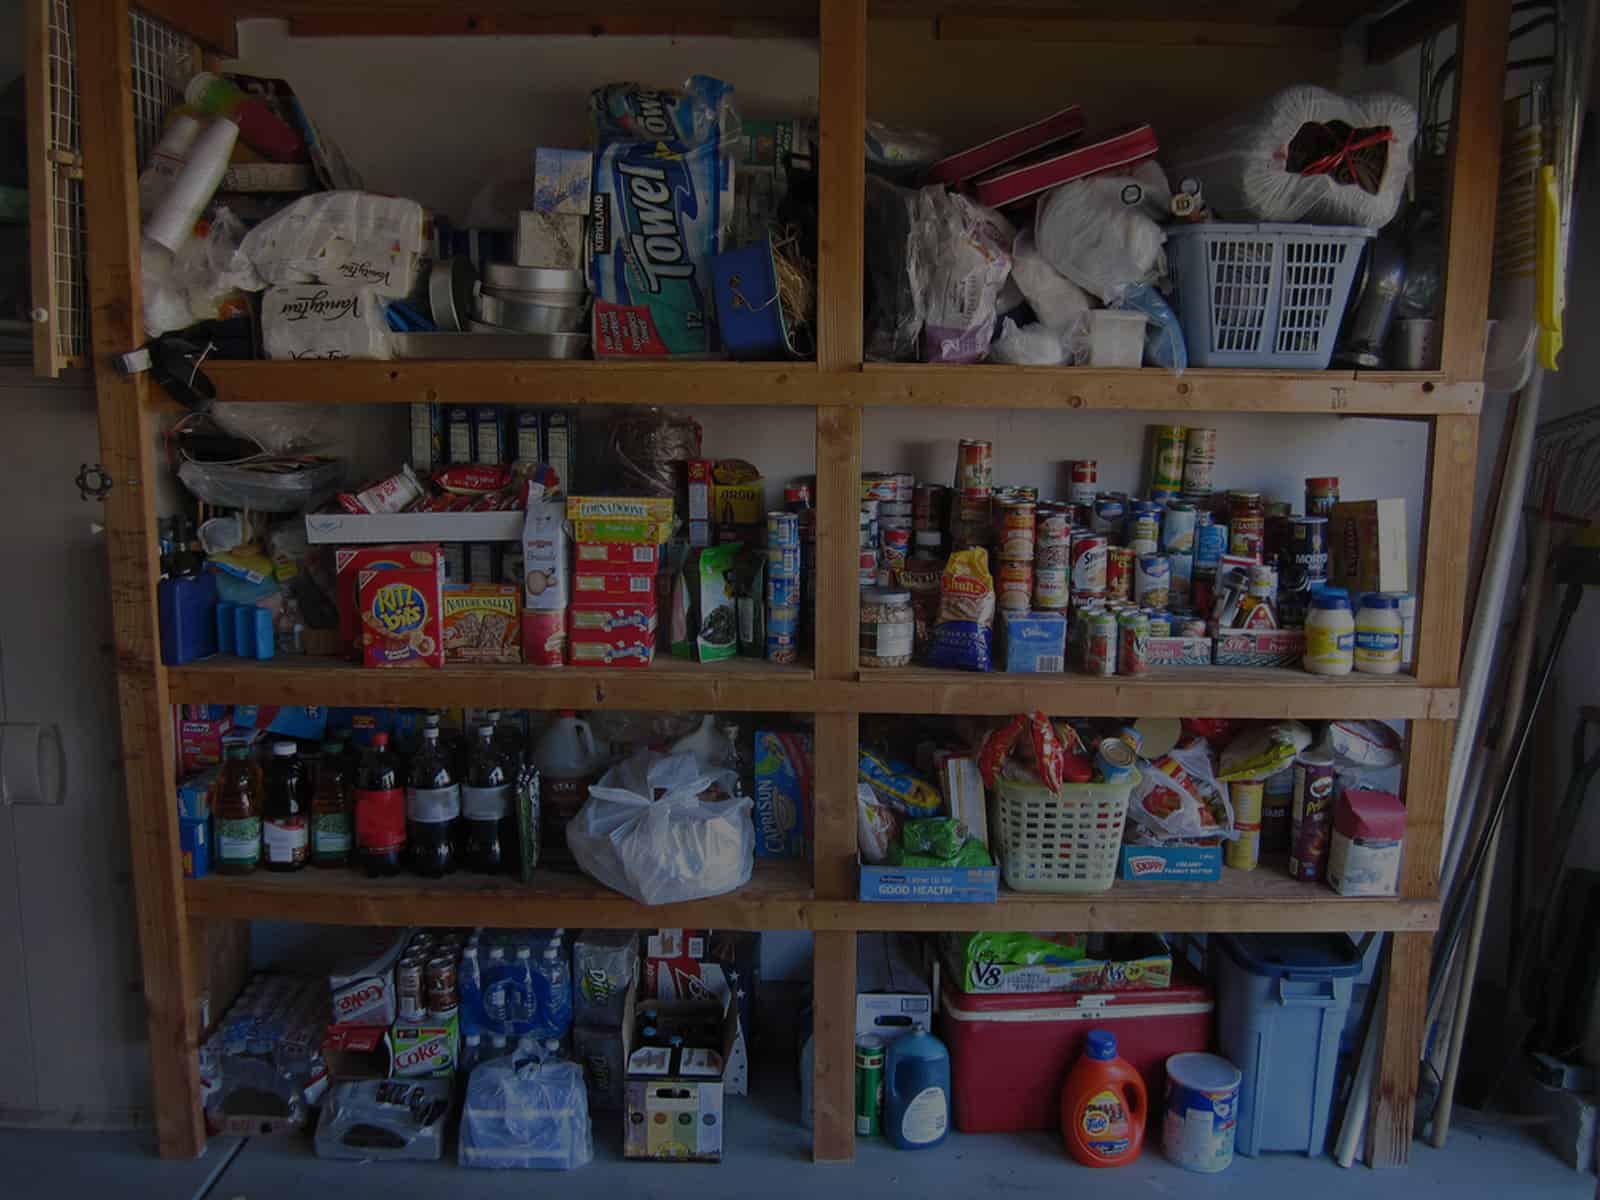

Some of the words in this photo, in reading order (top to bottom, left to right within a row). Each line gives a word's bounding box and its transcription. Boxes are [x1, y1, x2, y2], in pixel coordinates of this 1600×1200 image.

[594, 195, 605, 251] KIRKLAND
[615, 160, 696, 294] Towel
[376, 585, 416, 613] RITZ
[446, 599, 479, 612] NATURE
[480, 599, 516, 612] VALLEY
[879, 885, 909, 895] GOOD
[912, 885, 953, 895] HEALTH
[975, 960, 1001, 986] V8
[395, 1043, 440, 1068] Coke
